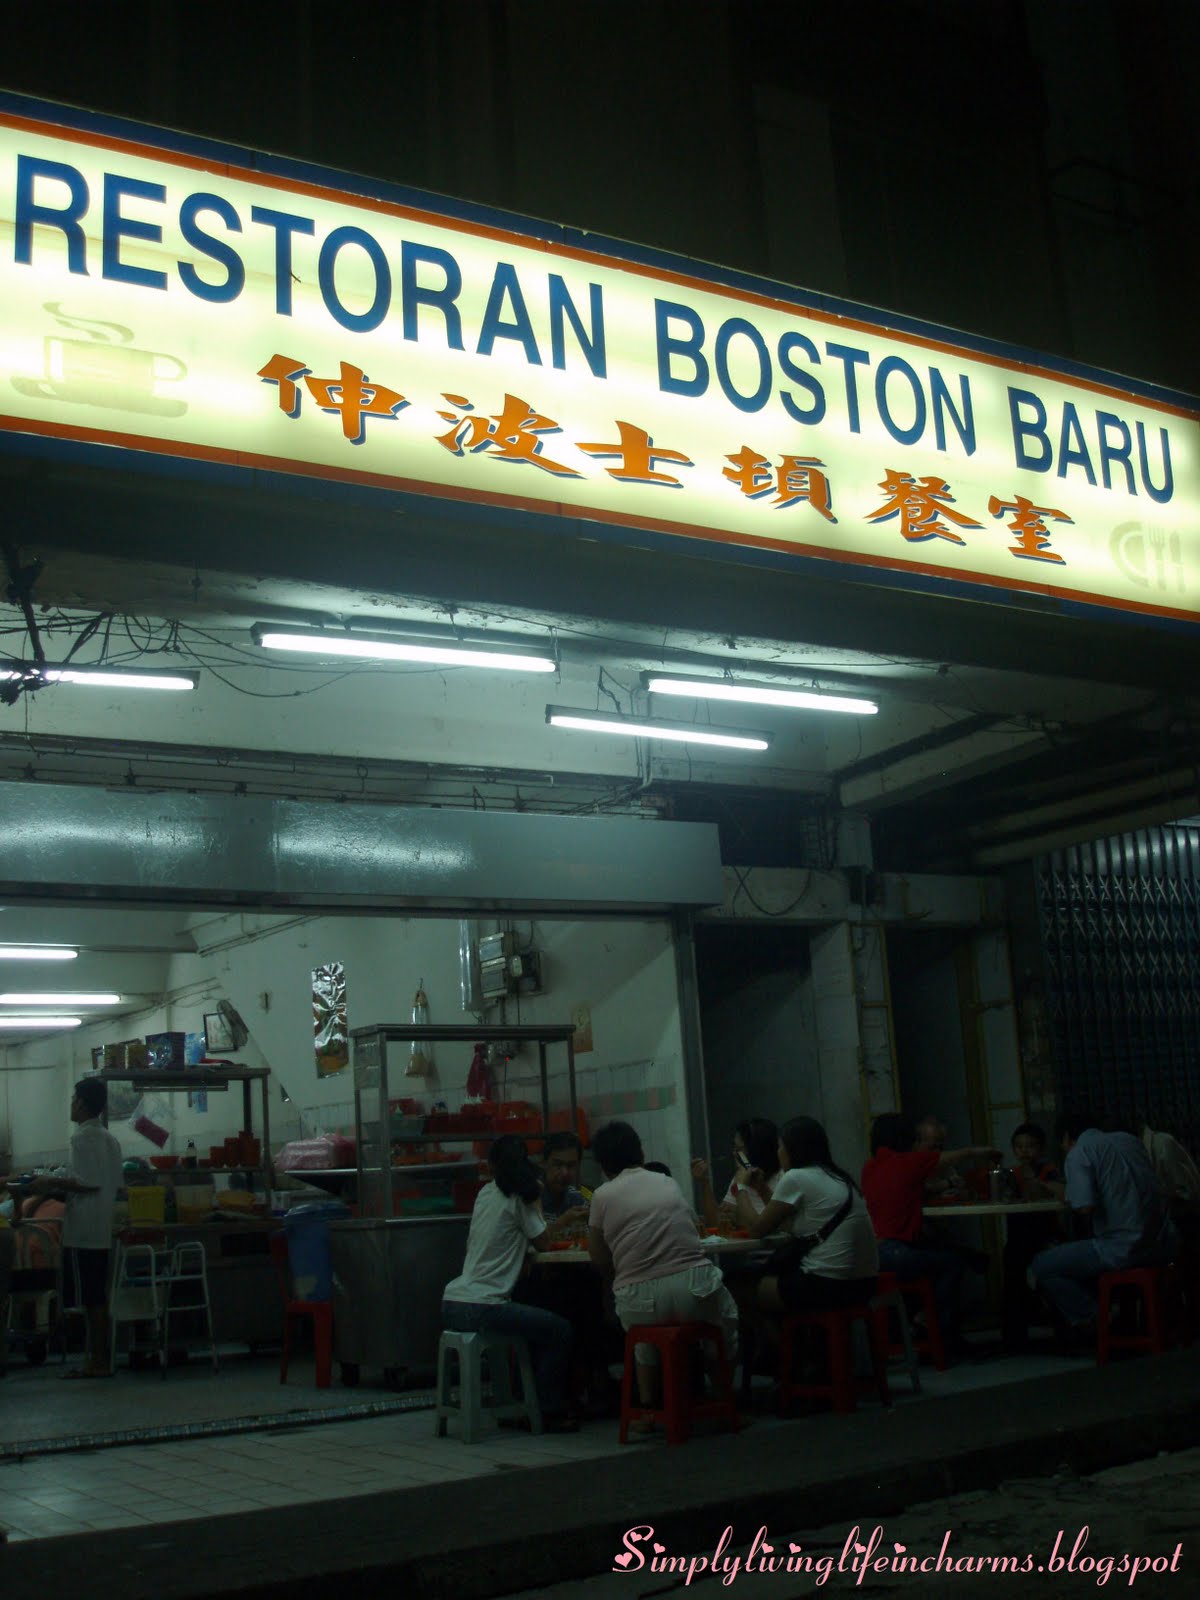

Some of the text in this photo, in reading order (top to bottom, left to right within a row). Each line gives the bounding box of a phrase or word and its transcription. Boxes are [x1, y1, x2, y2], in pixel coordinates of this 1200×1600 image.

[14, 154, 1174, 504] RESTORAN BOSTON BARU
